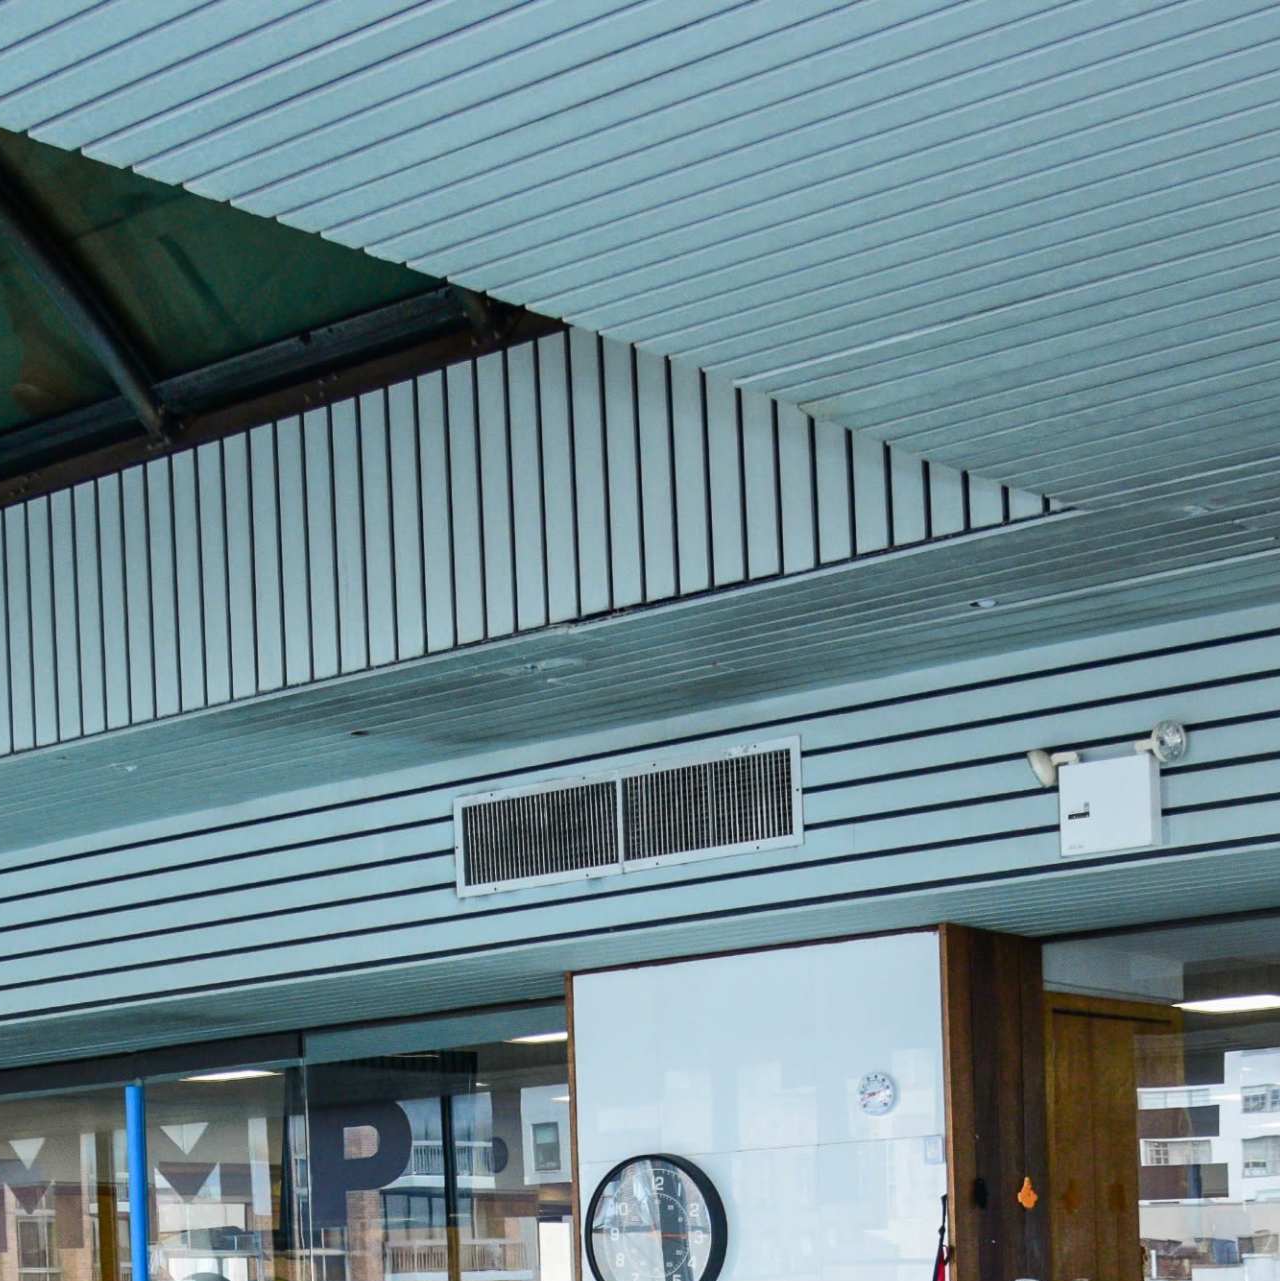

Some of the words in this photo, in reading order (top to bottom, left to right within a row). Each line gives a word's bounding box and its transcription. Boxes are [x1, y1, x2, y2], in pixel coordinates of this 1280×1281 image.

[651, 1176, 665, 1191] 12
[689, 1203, 700, 1217] 2
[610, 1228, 619, 1241] 9
[694, 1231, 704, 1244] 3
[615, 1254, 625, 1267] 8
[687, 1256, 697, 1269] 4
